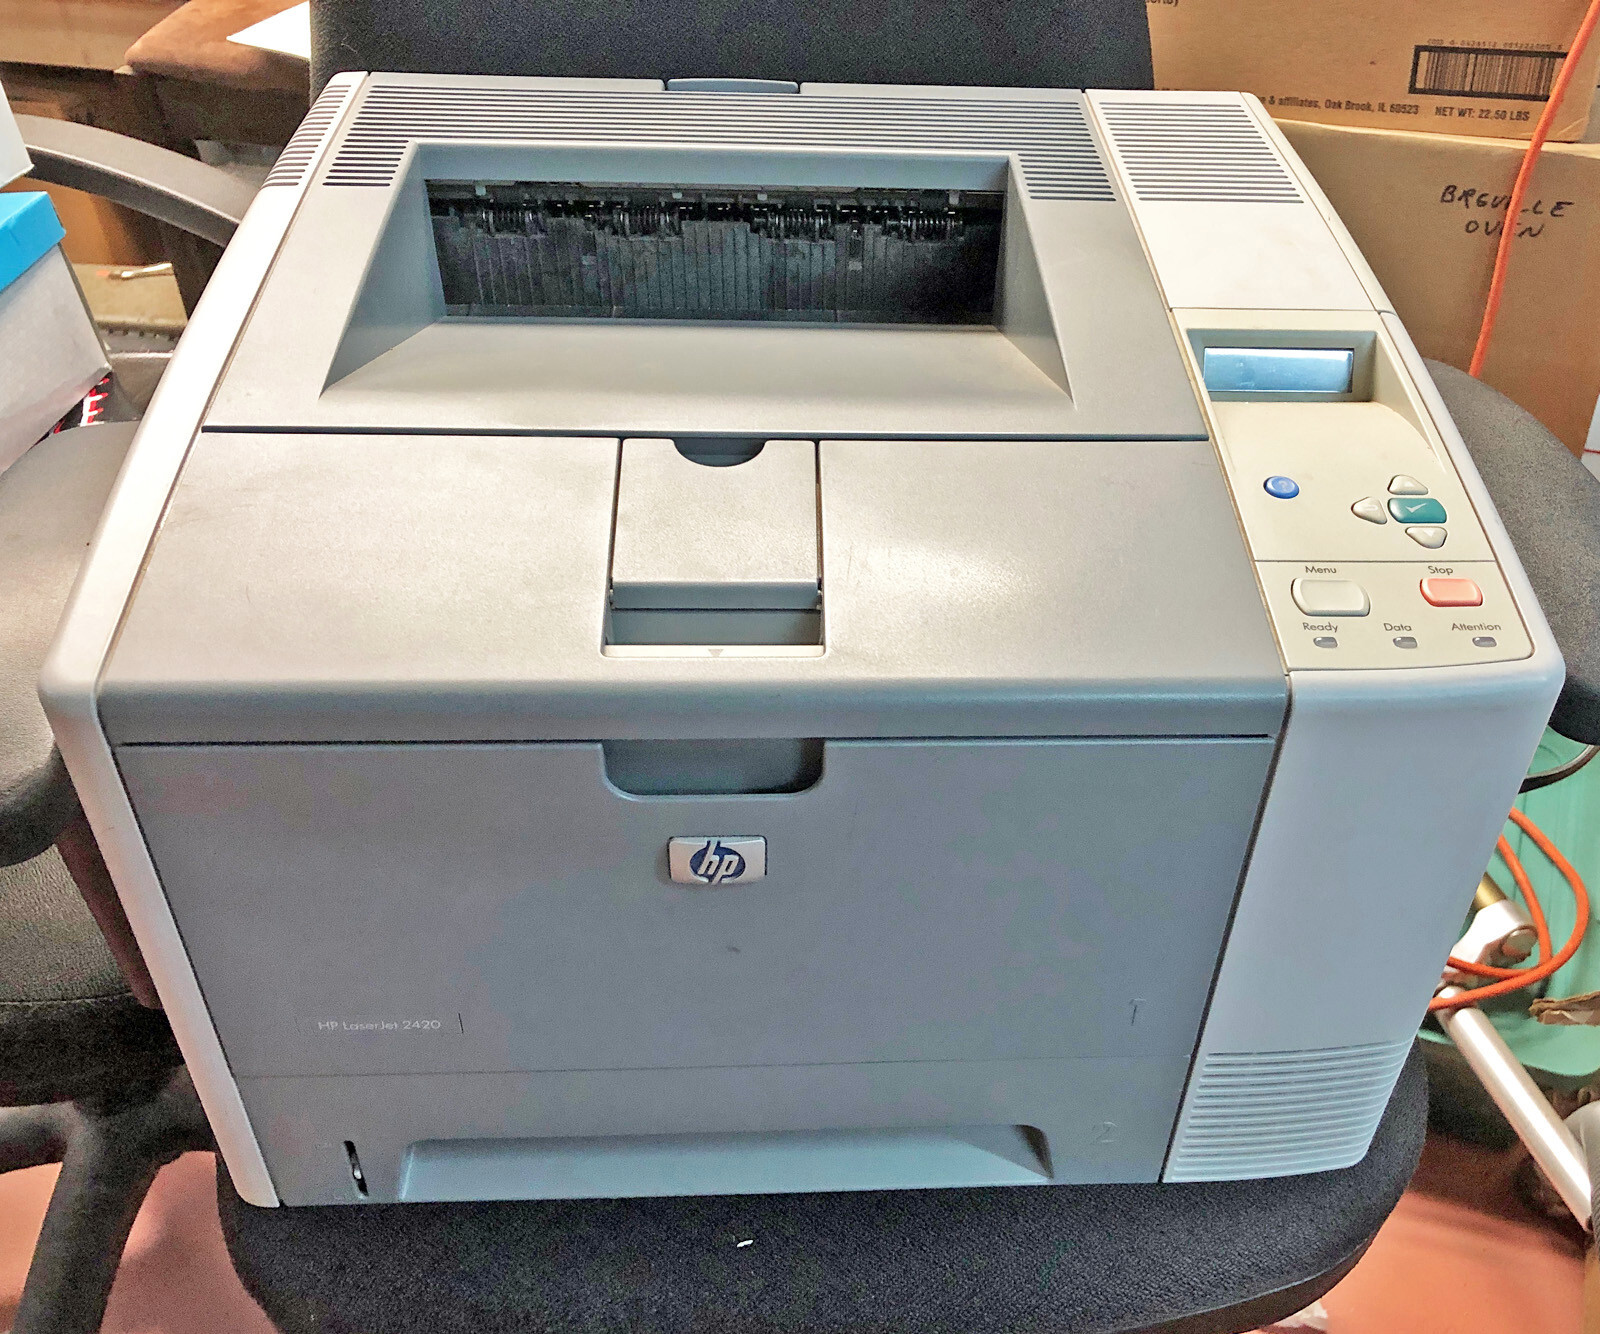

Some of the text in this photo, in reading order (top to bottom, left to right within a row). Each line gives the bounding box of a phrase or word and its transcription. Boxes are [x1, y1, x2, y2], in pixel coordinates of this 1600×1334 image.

[1268, 95, 1275, 105] &
[1278, 97, 1321, 110] affiliates,
[1324, 99, 1342, 110] Oak
[1344, 101, 1374, 113] Brook,
[1377, 103, 1386, 113] IL
[1389, 103, 1419, 115] 60523
[1435, 106, 1530, 122] NET WT: 22.50 LBS
[1464, 220, 1544, 238] OVN
[1305, 566, 1337, 575] Menu
[1428, 565, 1454, 576] Stop
[1303, 622, 1339, 634] Ready
[1384, 622, 1412, 632] Data
[1451, 622, 1502, 632] Attention
[697, 840, 740, 885] hp
[317, 1020, 441, 1031] HP LaserJet 2420
